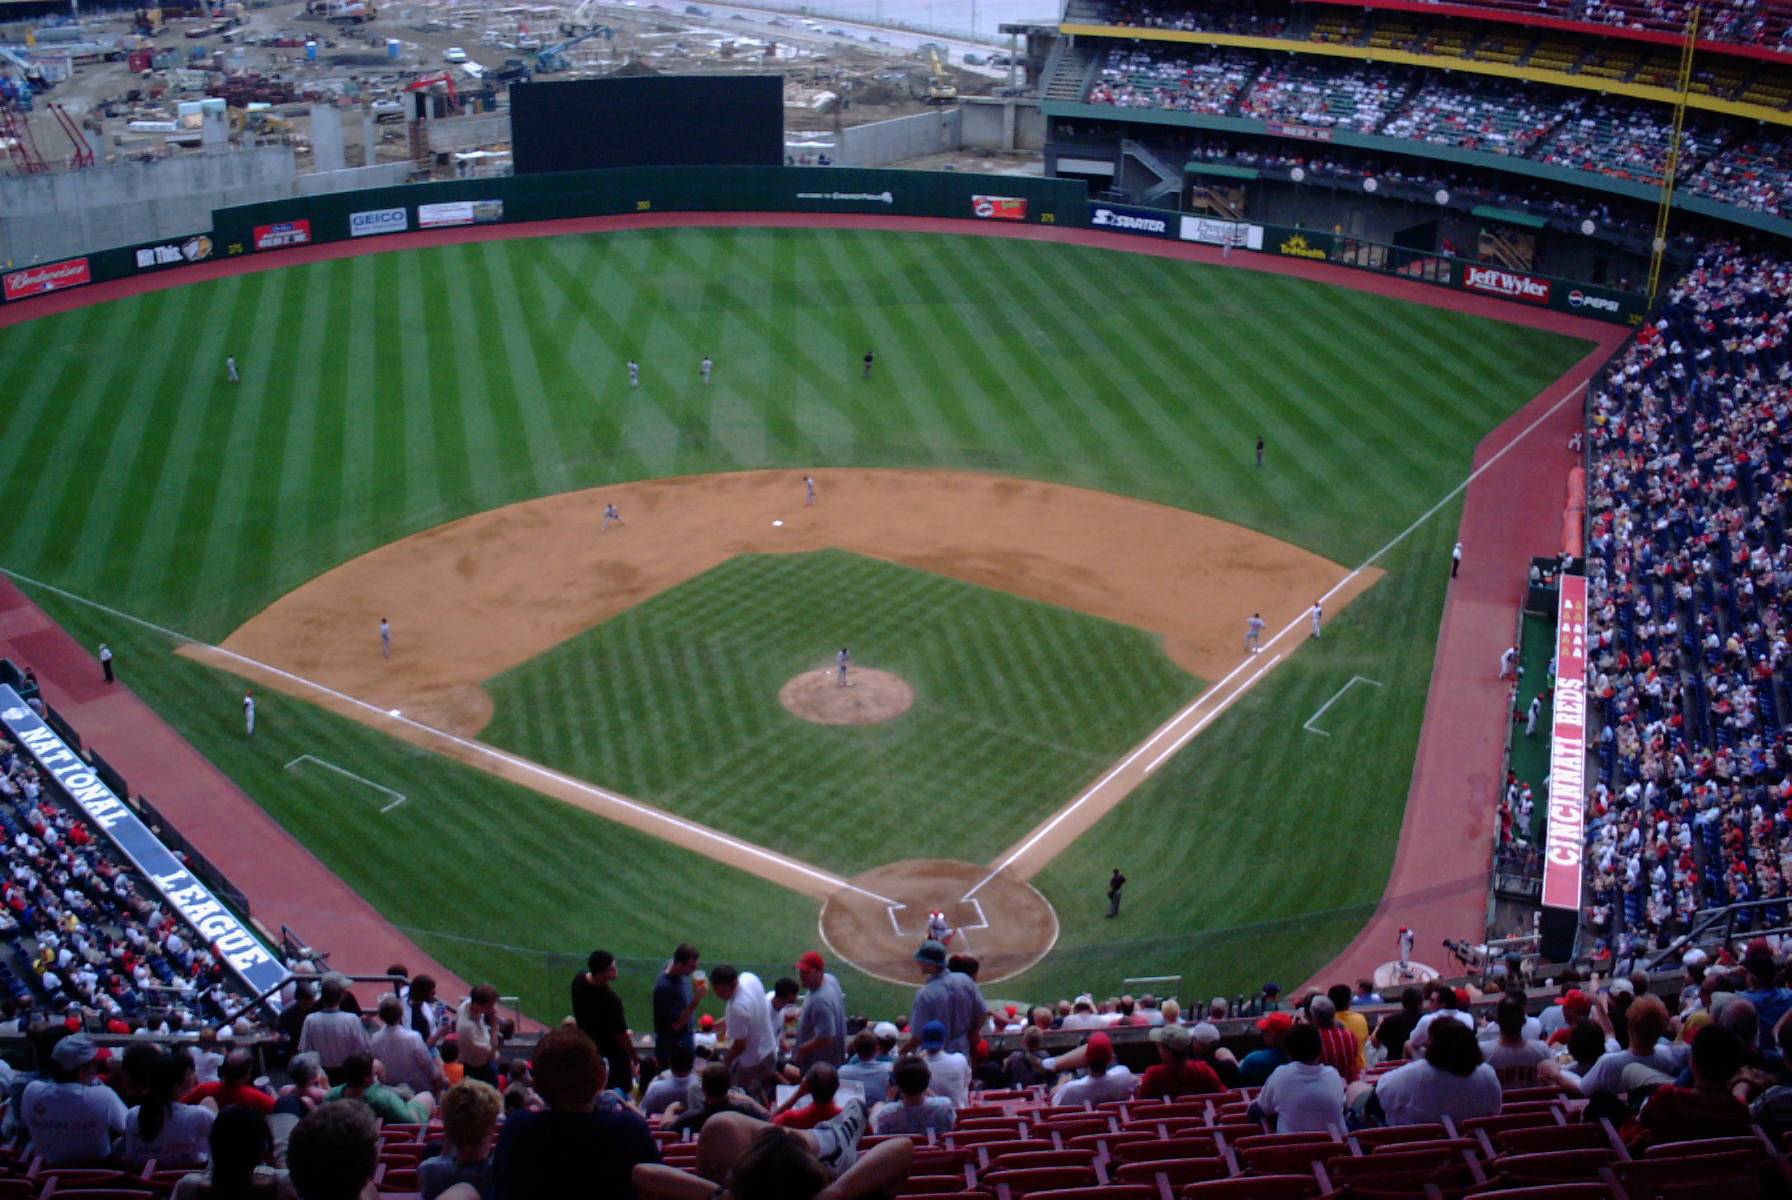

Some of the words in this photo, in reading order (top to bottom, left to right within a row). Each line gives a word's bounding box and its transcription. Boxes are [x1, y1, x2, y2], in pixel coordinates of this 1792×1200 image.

[353, 210, 404, 226] GEICO
[8, 264, 85, 291] Budweiser
[1466, 267, 1500, 287] Jeff
[1501, 273, 1548, 296] Wyler
[1583, 296, 1619, 312] PEPSI
[1556, 677, 1584, 727] REDS
[1549, 736, 1582, 866] CINCINNATI
[19, 726, 128, 828] NATIONAL
[151, 869, 270, 971] LEAGUE
